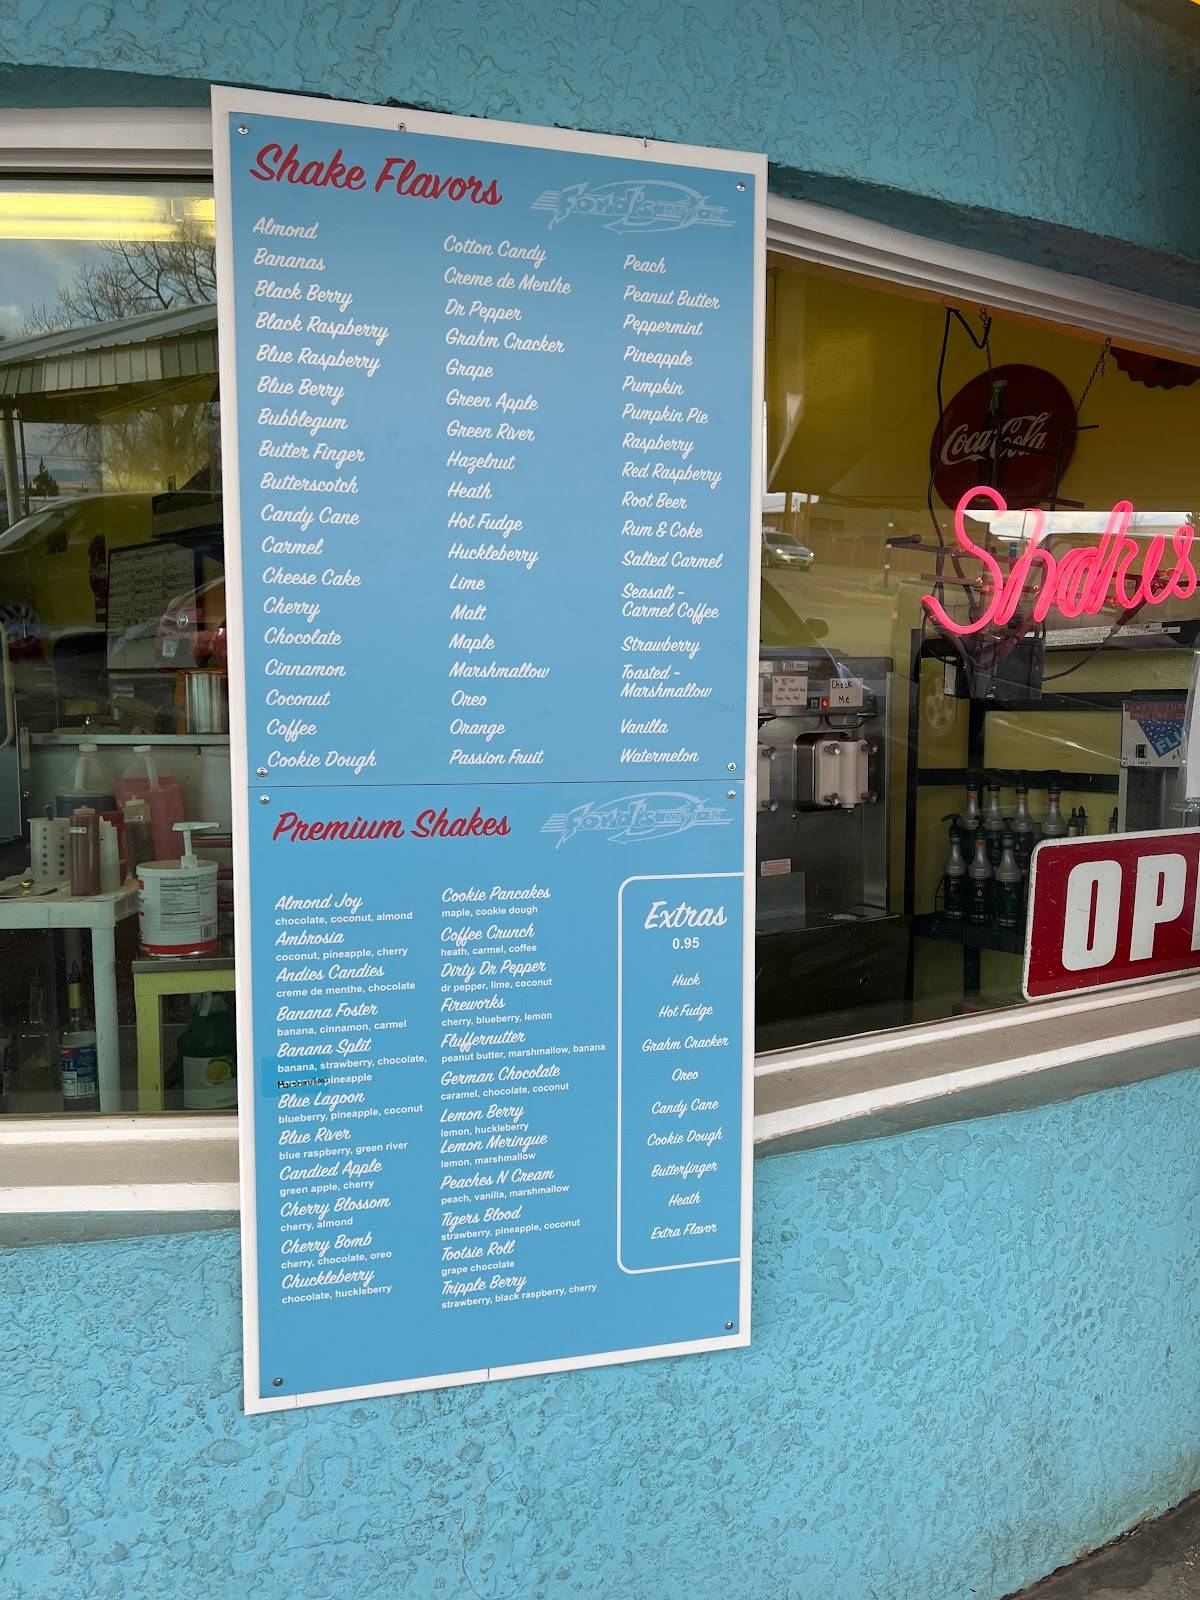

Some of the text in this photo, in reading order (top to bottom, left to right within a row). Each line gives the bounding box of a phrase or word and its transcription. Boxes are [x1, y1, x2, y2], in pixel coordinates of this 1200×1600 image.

[249, 143, 503, 206] Shake Flavors
[253, 217, 319, 239] Almond
[444, 235, 546, 269] Cotton Candy
[623, 254, 666, 274] Peach
[254, 280, 353, 312] Black Berry
[623, 285, 720, 309] Peanut Butter
[445, 298, 522, 323] Dr Pepper
[255, 312, 389, 346] Black Raspberry
[623, 314, 703, 336] Peppermint
[623, 345, 693, 369] Pineapple
[446, 358, 494, 381] Grape
[257, 375, 345, 406] Blue Berry
[446, 388, 538, 414] Green Apple
[257, 408, 348, 436] Bubblegum
[622, 403, 708, 424] Pumpkin Pie
[446, 450, 516, 474] Hazelnut
[260, 472, 359, 493] Butterscotch
[622, 461, 722, 490] Red Raspberry
[621, 491, 687, 509] Root Beer
[261, 504, 360, 531] Candy Cane
[447, 512, 524, 539] Hot Fudge
[448, 542, 539, 570] Huckleberry
[621, 550, 723, 568] Salted Carmel
[921, 485, 1197, 634] Shakes
[262, 566, 361, 587] Cheese Cake
[449, 573, 486, 590] Lime
[621, 582, 675, 599] Seasalt
[263, 596, 321, 624] Cherry
[448, 633, 495, 654] Maple
[620, 636, 701, 660] Strawberry
[265, 658, 346, 677] Cinnamon
[449, 661, 550, 679] Marshmallow
[621, 664, 672, 680] Toasted
[266, 689, 331, 706] Coconut
[620, 681, 712, 698] Marshmallow
[621, 718, 669, 734] Vanilla
[267, 750, 377, 775] Cookie Dough
[449, 749, 544, 765] Passion Fruit
[620, 747, 700, 763] Watermelon
[272, 806, 512, 842] Premium Shakes
[274, 892, 364, 914] Almond Joy
[441, 884, 551, 903] Cookie Pancakes
[275, 911, 413, 926] chocolate, coconut, almond
[441, 905, 538, 918] maple, cookie dough
[644, 900, 728, 930] Extras
[275, 929, 345, 946] Ambrosia
[672, 937, 699, 950] 0.95
[276, 947, 408, 962] coconut, pineapple, cherry
[441, 944, 537, 957] heath, carmel, coffee
[276, 963, 385, 982] Andies Candies
[440, 959, 547, 983] Dirty Dr Pepper
[672, 972, 701, 986] Huck
[440, 993, 506, 1012] Fireworks
[277, 1019, 407, 1037] banana, cinnamon, carmel
[441, 1012, 552, 1027] cherry, blueberry, lemon
[277, 1037, 372, 1058] Banana Split
[440, 1030, 526, 1053] Fluffernutter
[642, 1034, 729, 1052] Grahm Cracker
[440, 1064, 561, 1086] German Chocolate
[671, 1068, 699, 1081] Oreo
[440, 1082, 569, 1100] caramel, chocolate, coconut
[277, 1092, 365, 1112] Blue Lagoon
[651, 1098, 720, 1119] Candy Cane
[278, 1104, 423, 1124] blueberry, pineapple, coconut
[439, 1104, 525, 1123] Lemon Berry
[440, 1134, 548, 1154] Lemon Meringue
[647, 1127, 723, 1147] Cookie Dough
[279, 1158, 383, 1181] Candied Apple
[441, 1152, 536, 1168] lemon, marshmallow
[651, 1161, 719, 1180] Butterfinger
[280, 1181, 374, 1198] green apple, cherry
[441, 1185, 570, 1206] peach, vanilla, marshmallow
[280, 1196, 391, 1220] Cherry Blossom
[441, 1204, 523, 1232] Tigers Blood
[280, 1217, 353, 1232] cherry, almond
[441, 1218, 581, 1241] strawberry, pineapple, coconut
[651, 1223, 718, 1240] Extra Flavor
[441, 1260, 515, 1277] grape chocolate
[281, 1269, 375, 1289] Chuckleberry
[442, 1274, 528, 1298] Tripple Berry
[282, 1284, 392, 1304] chocolate, huckleberry
